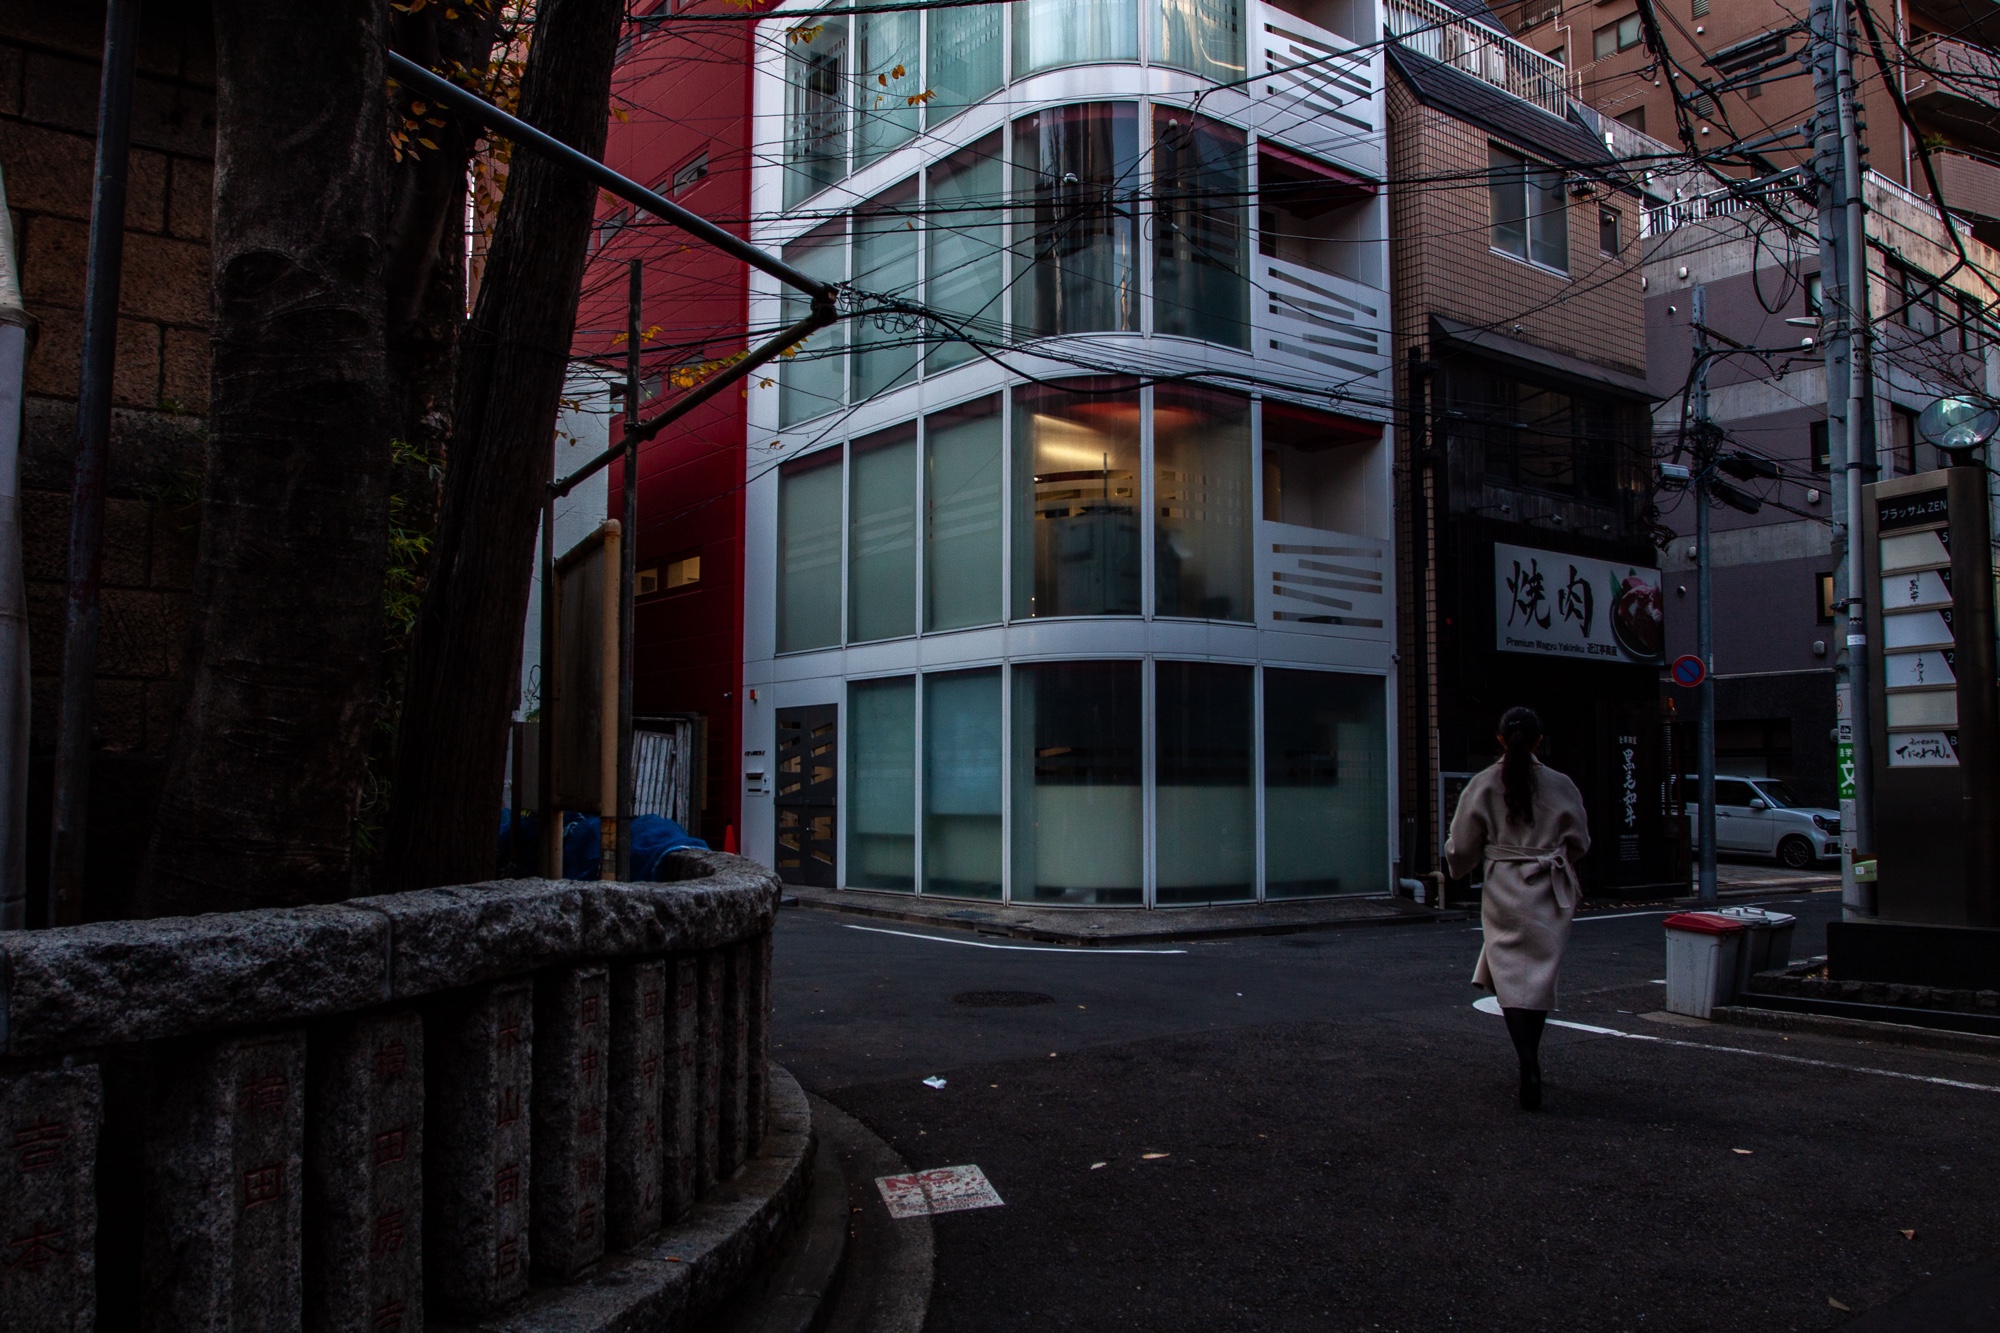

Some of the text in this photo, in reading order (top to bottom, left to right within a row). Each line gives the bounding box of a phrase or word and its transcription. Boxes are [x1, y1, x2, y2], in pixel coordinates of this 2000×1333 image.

[1927, 499, 1947, 513] ZEN
[1941, 531, 1949, 543] 5
[1943, 570, 1950, 582] 4
[1506, 558, 1593, 639] 焼肉
[1944, 611, 1952, 623] 3
[1506, 636, 1535, 648] Premium
[1535, 640, 1558, 651] Wagyu
[1558, 642, 1585, 653] Yakiniku
[1947, 652, 1955, 664] 2
[1621, 748, 1638, 828] 黒毛和牛
[237, 1068, 288, 1210] 横田
[495, 1010, 521, 1282] 米山商店
[5, 1114, 71, 1271] 吉本
